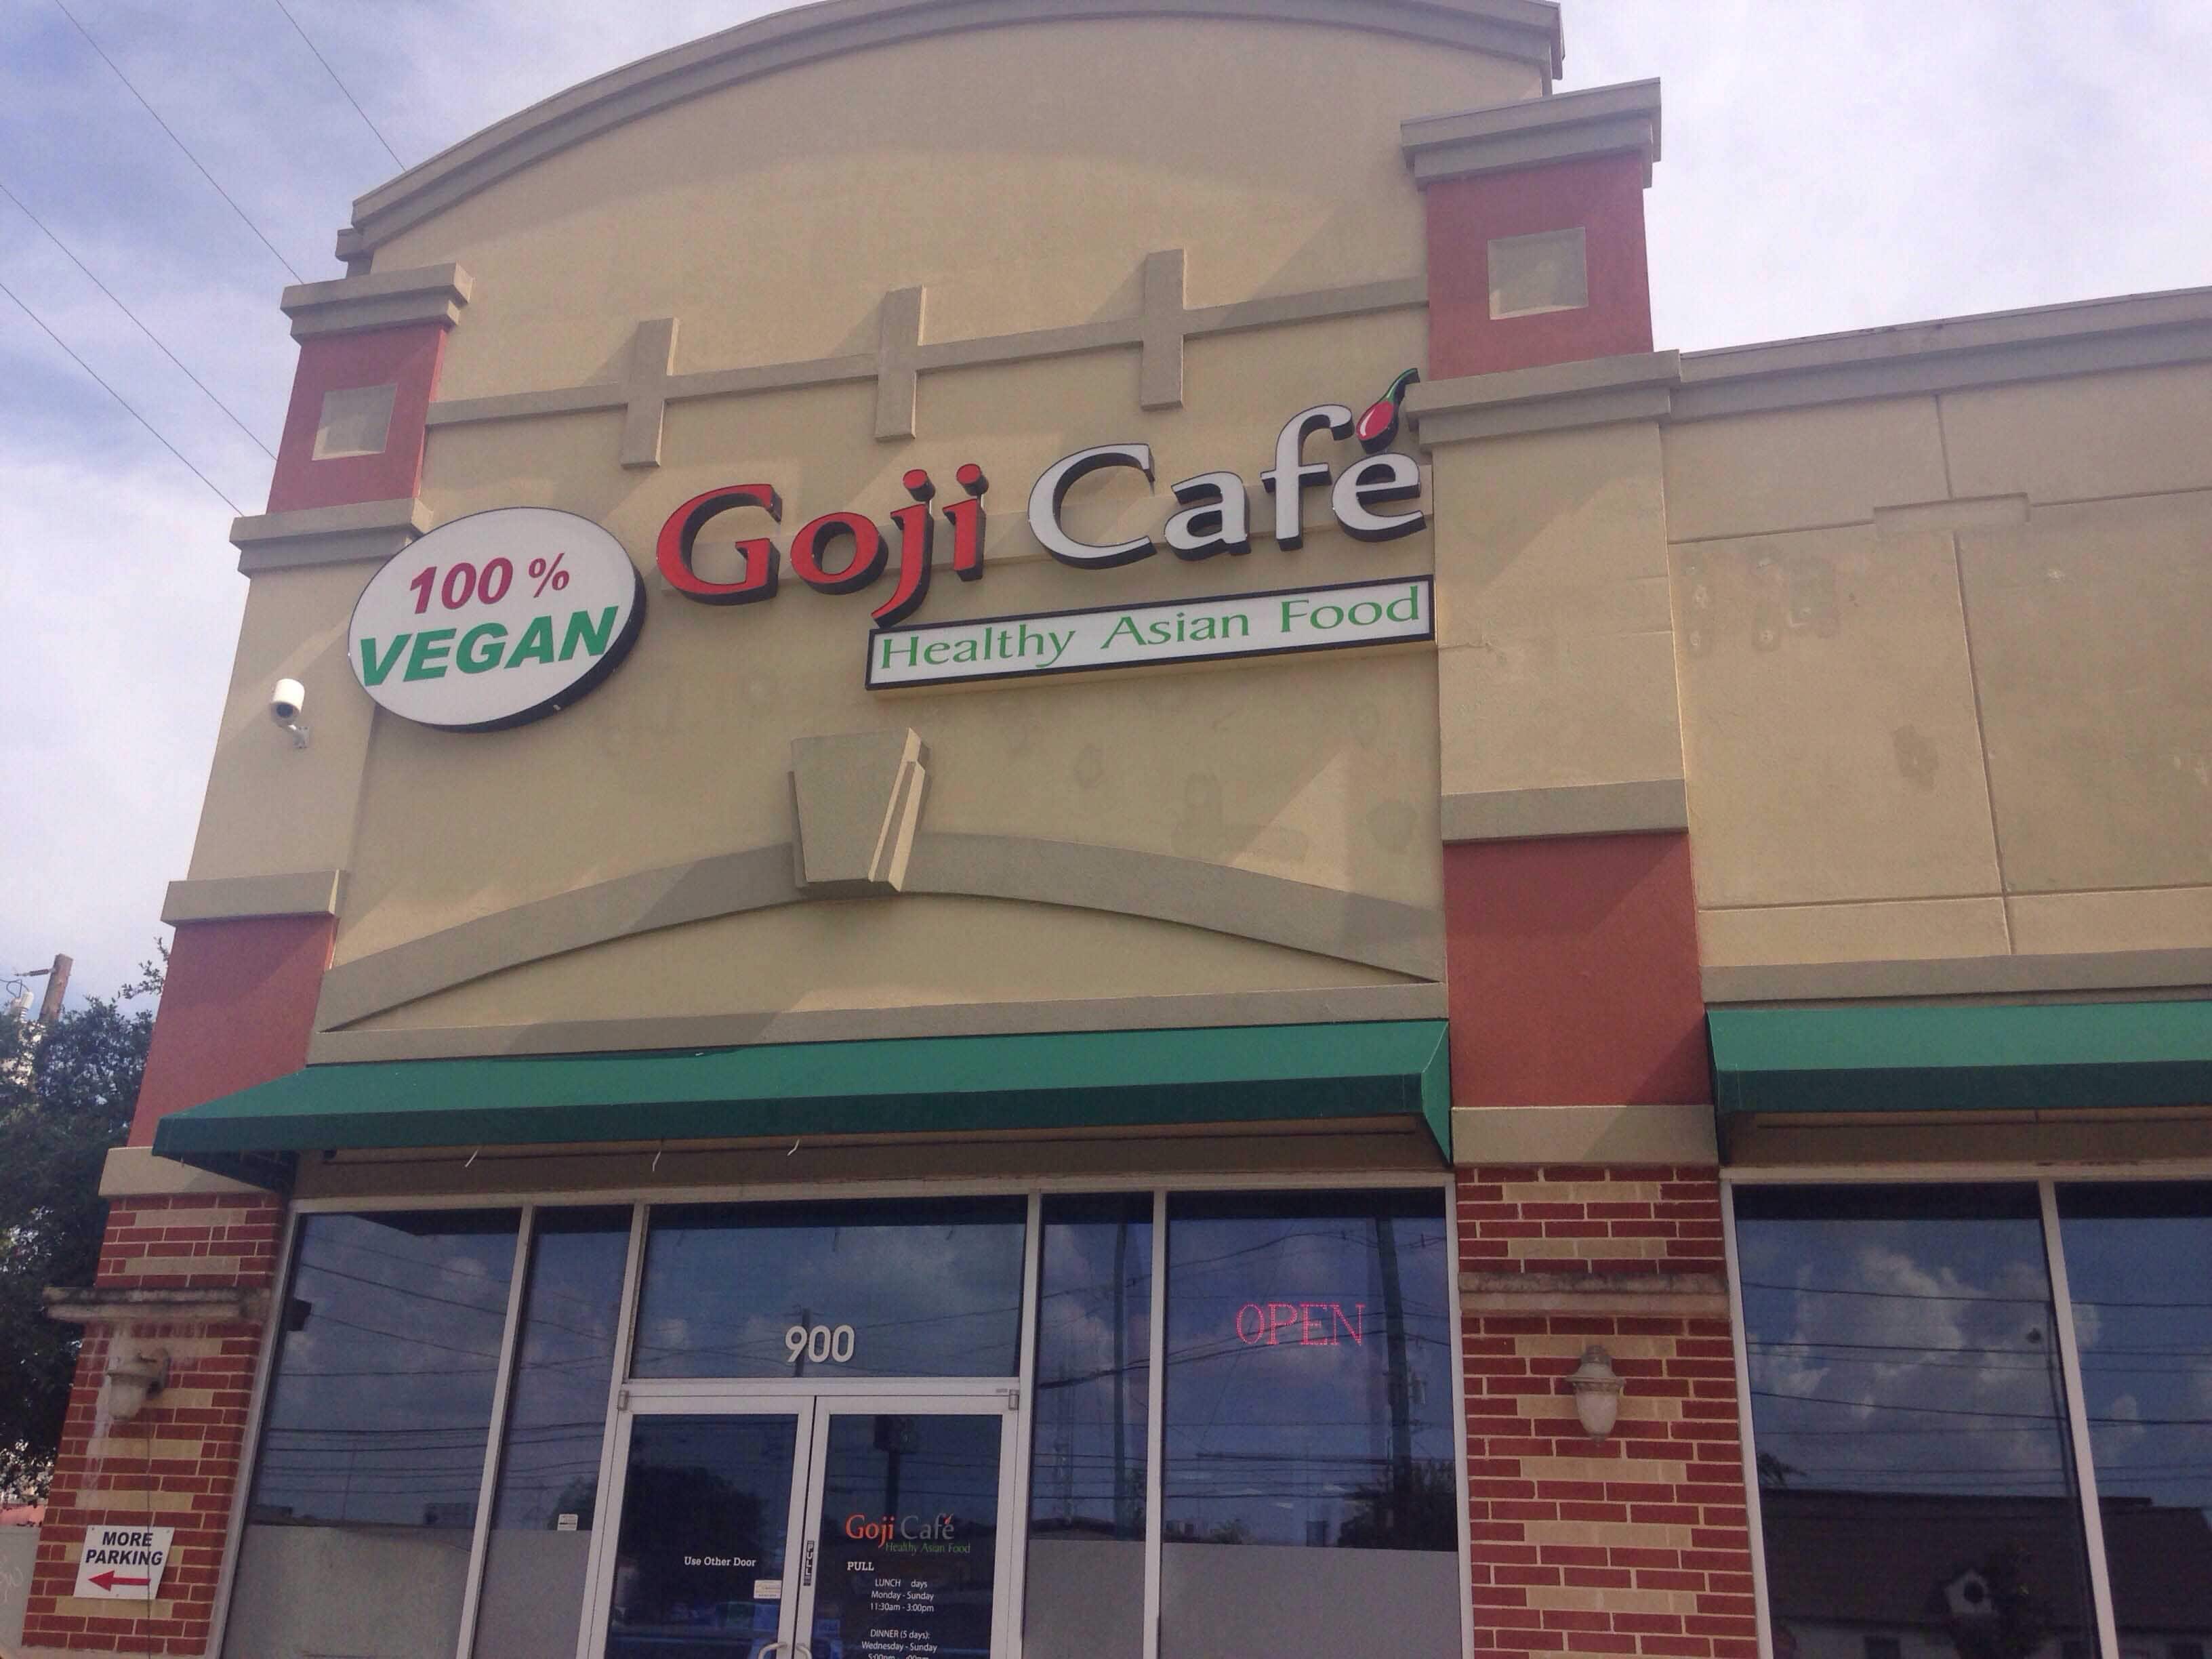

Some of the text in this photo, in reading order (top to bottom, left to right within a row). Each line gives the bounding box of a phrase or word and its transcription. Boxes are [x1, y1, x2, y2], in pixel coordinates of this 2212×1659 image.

[656, 368, 1427, 627] Goji Café
[409, 552, 569, 615] 100 %
[880, 585, 1418, 668] Healthy Asian Food
[361, 605, 619, 687] VEGAN
[1235, 1301, 1366, 1346] OPEN
[785, 1325, 855, 1362] 900
[846, 1513, 954, 1548] Goji Café
[102, 1532, 153, 1547] MORE
[885, 1541, 918, 1556] Healthy
[949, 1540, 970, 1553] Food
[85, 1549, 163, 1565] PARKING
[684, 1557, 756, 1567] Use Other Door
[847, 1561, 874, 1571] PULL
[875, 1578, 927, 1589] LUNCH days
[871, 1591, 901, 1601] Monday
[907, 1591, 934, 1602] Sunday
[870, 1603, 900, 1611] 11:30am
[906, 1603, 934, 1613] 3:00pm
[870, 1629, 899, 1638] DINNER
[861, 1641, 903, 1652] Wednesday
[910, 1643, 938, 1654] Sunday
